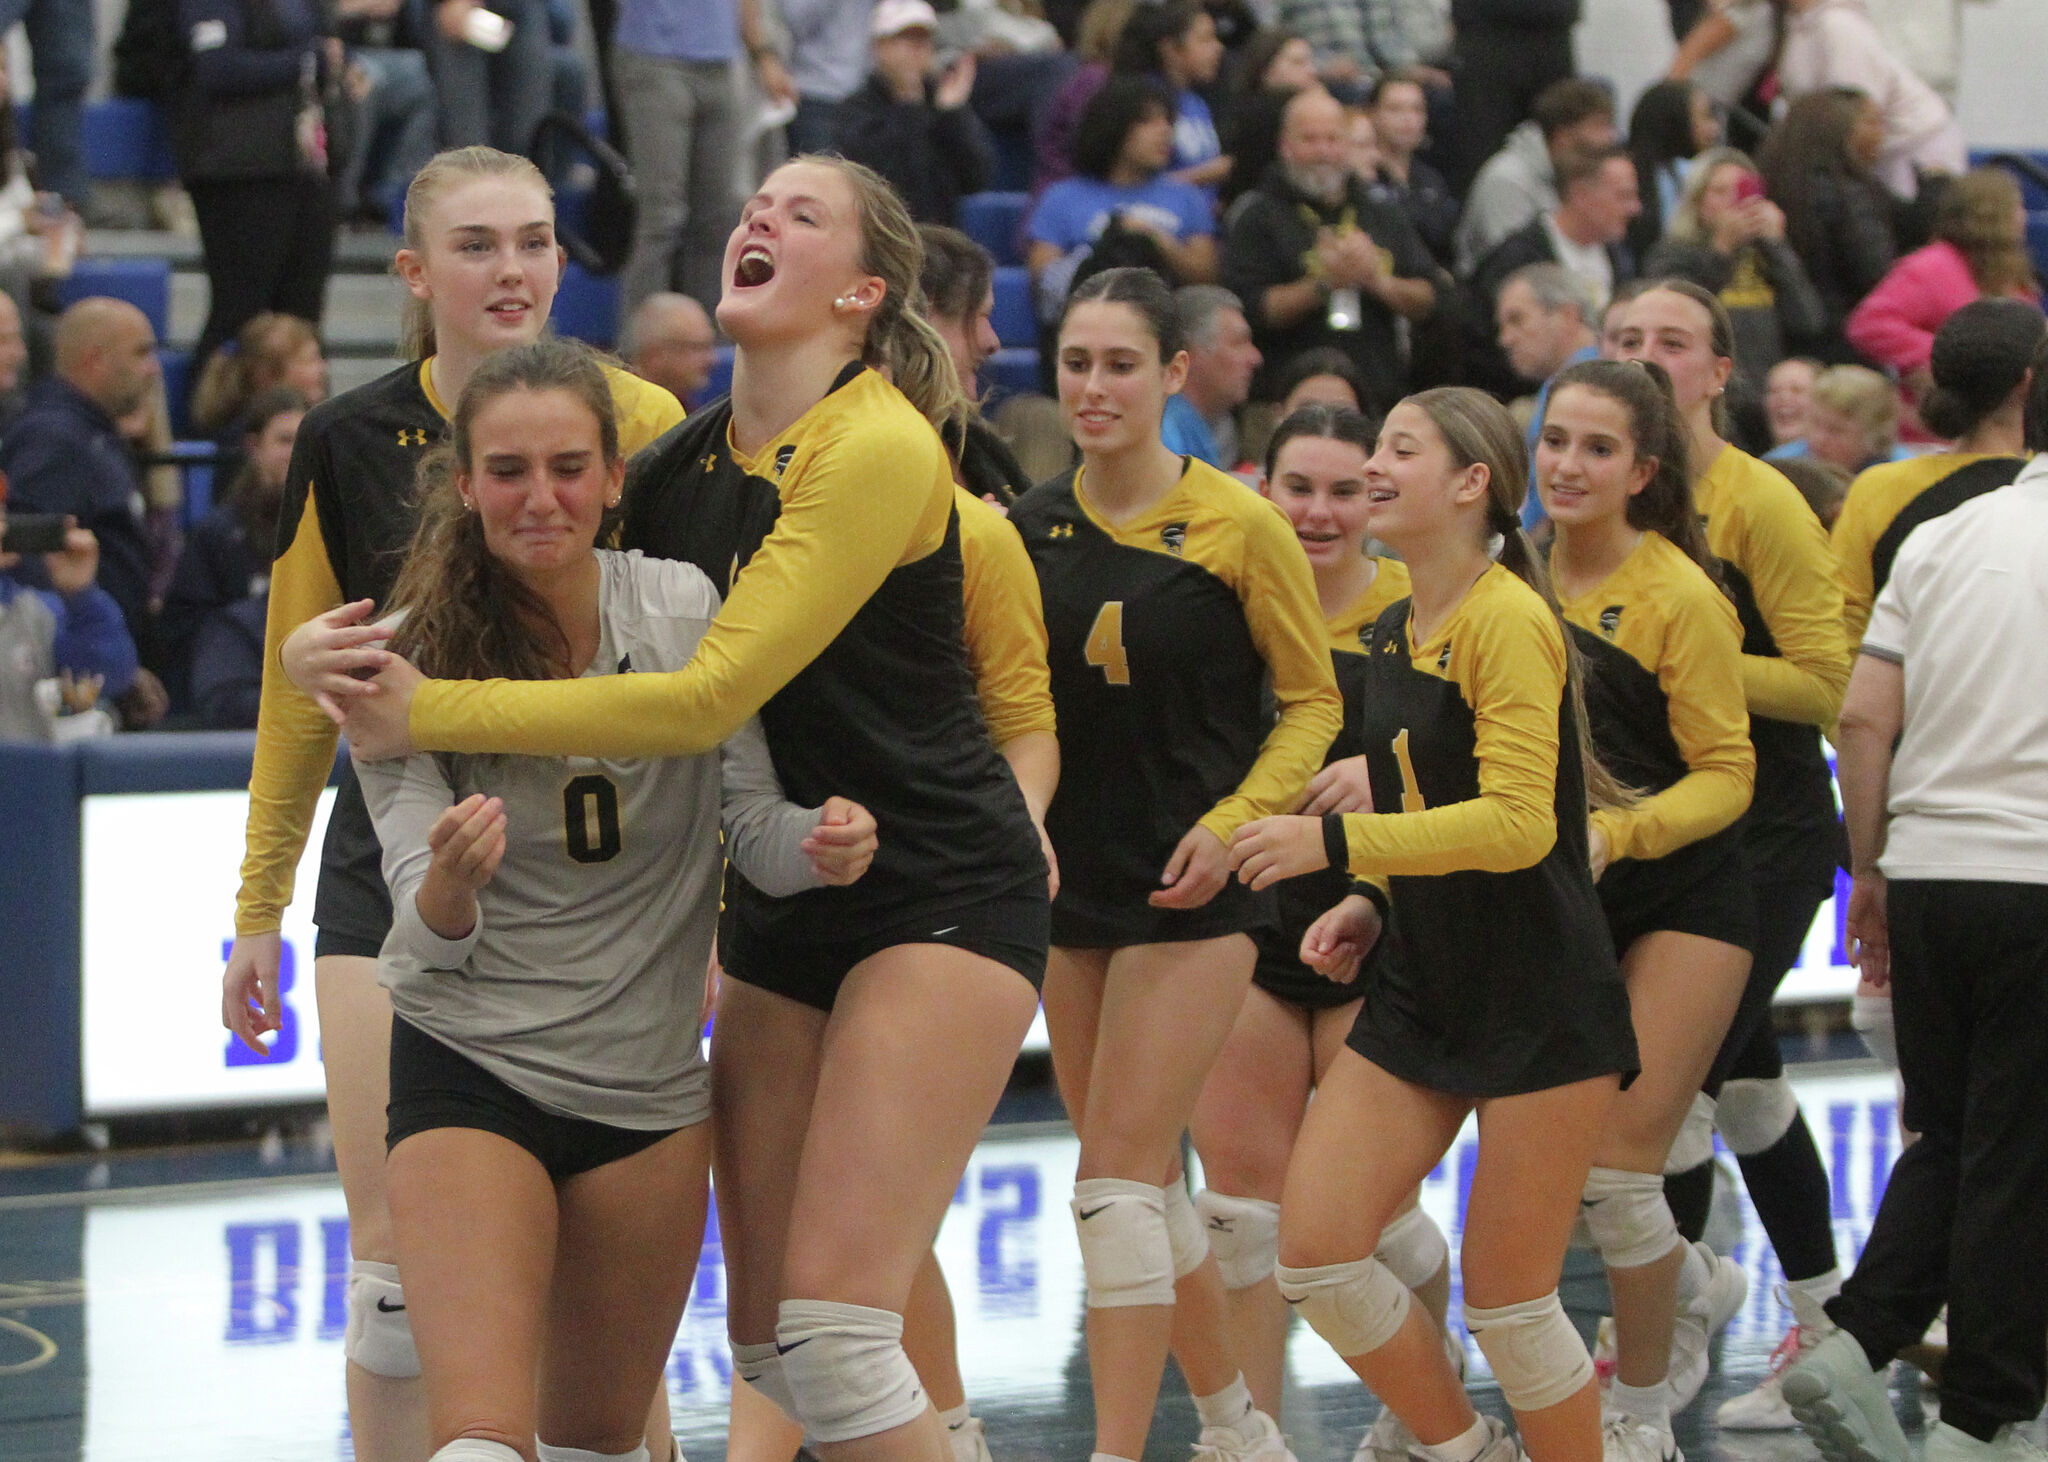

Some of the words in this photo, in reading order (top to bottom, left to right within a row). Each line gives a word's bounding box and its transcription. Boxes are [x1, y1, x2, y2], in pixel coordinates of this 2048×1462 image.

[1085, 601, 1130, 685] 4
[1392, 728, 1426, 813] 1
[562, 774, 622, 864] 0
